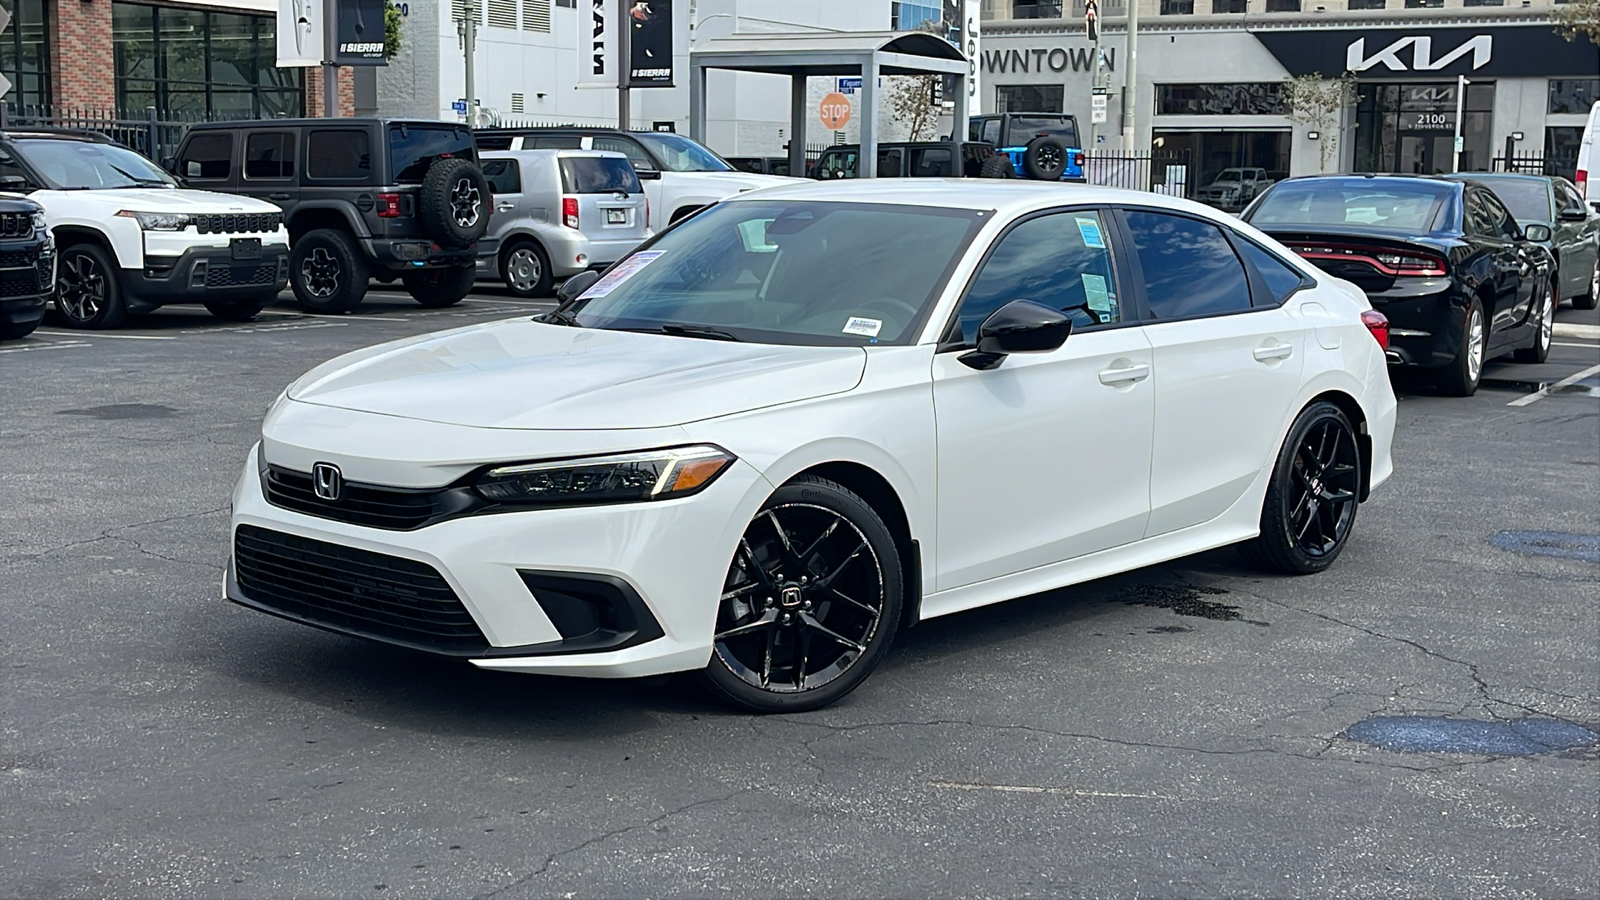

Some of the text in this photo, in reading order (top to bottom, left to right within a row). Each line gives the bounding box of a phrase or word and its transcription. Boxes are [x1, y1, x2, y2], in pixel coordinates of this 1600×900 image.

[346, 42, 384, 53] SIERRA
[1346, 34, 1493, 71] KIA
[980, 47, 1115, 74] WNTOWN
[637, 68, 671, 77] SIERRA
[821, 104, 850, 119] STOP
[1417, 114, 1446, 124] 2100
